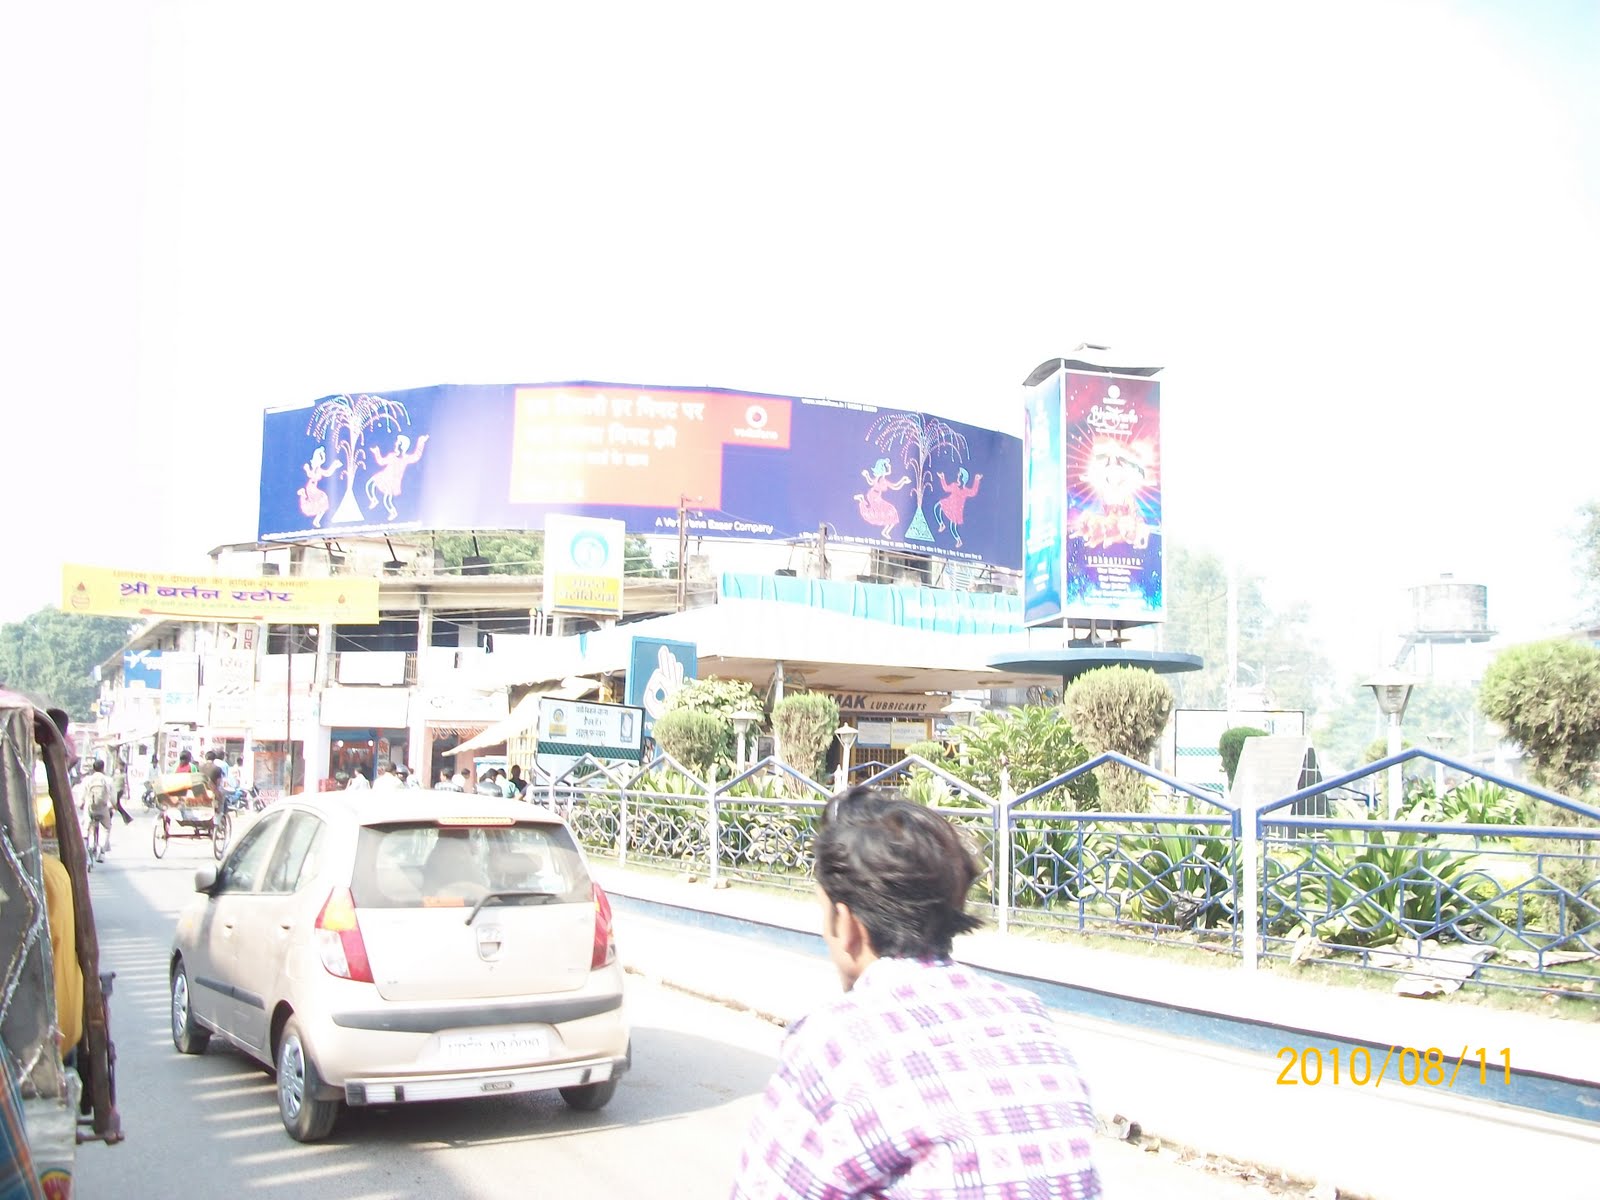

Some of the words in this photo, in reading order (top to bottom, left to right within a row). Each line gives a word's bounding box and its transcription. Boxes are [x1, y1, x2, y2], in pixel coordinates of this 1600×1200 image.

[655, 517, 663, 527] A
[734, 521, 774, 535] Company
[121, 580, 149, 596] श्री
[157, 585, 222, 599] बर्तन
[231, 589, 294, 602] स्टोर
[870, 701, 927, 711] LUBRICANTS
